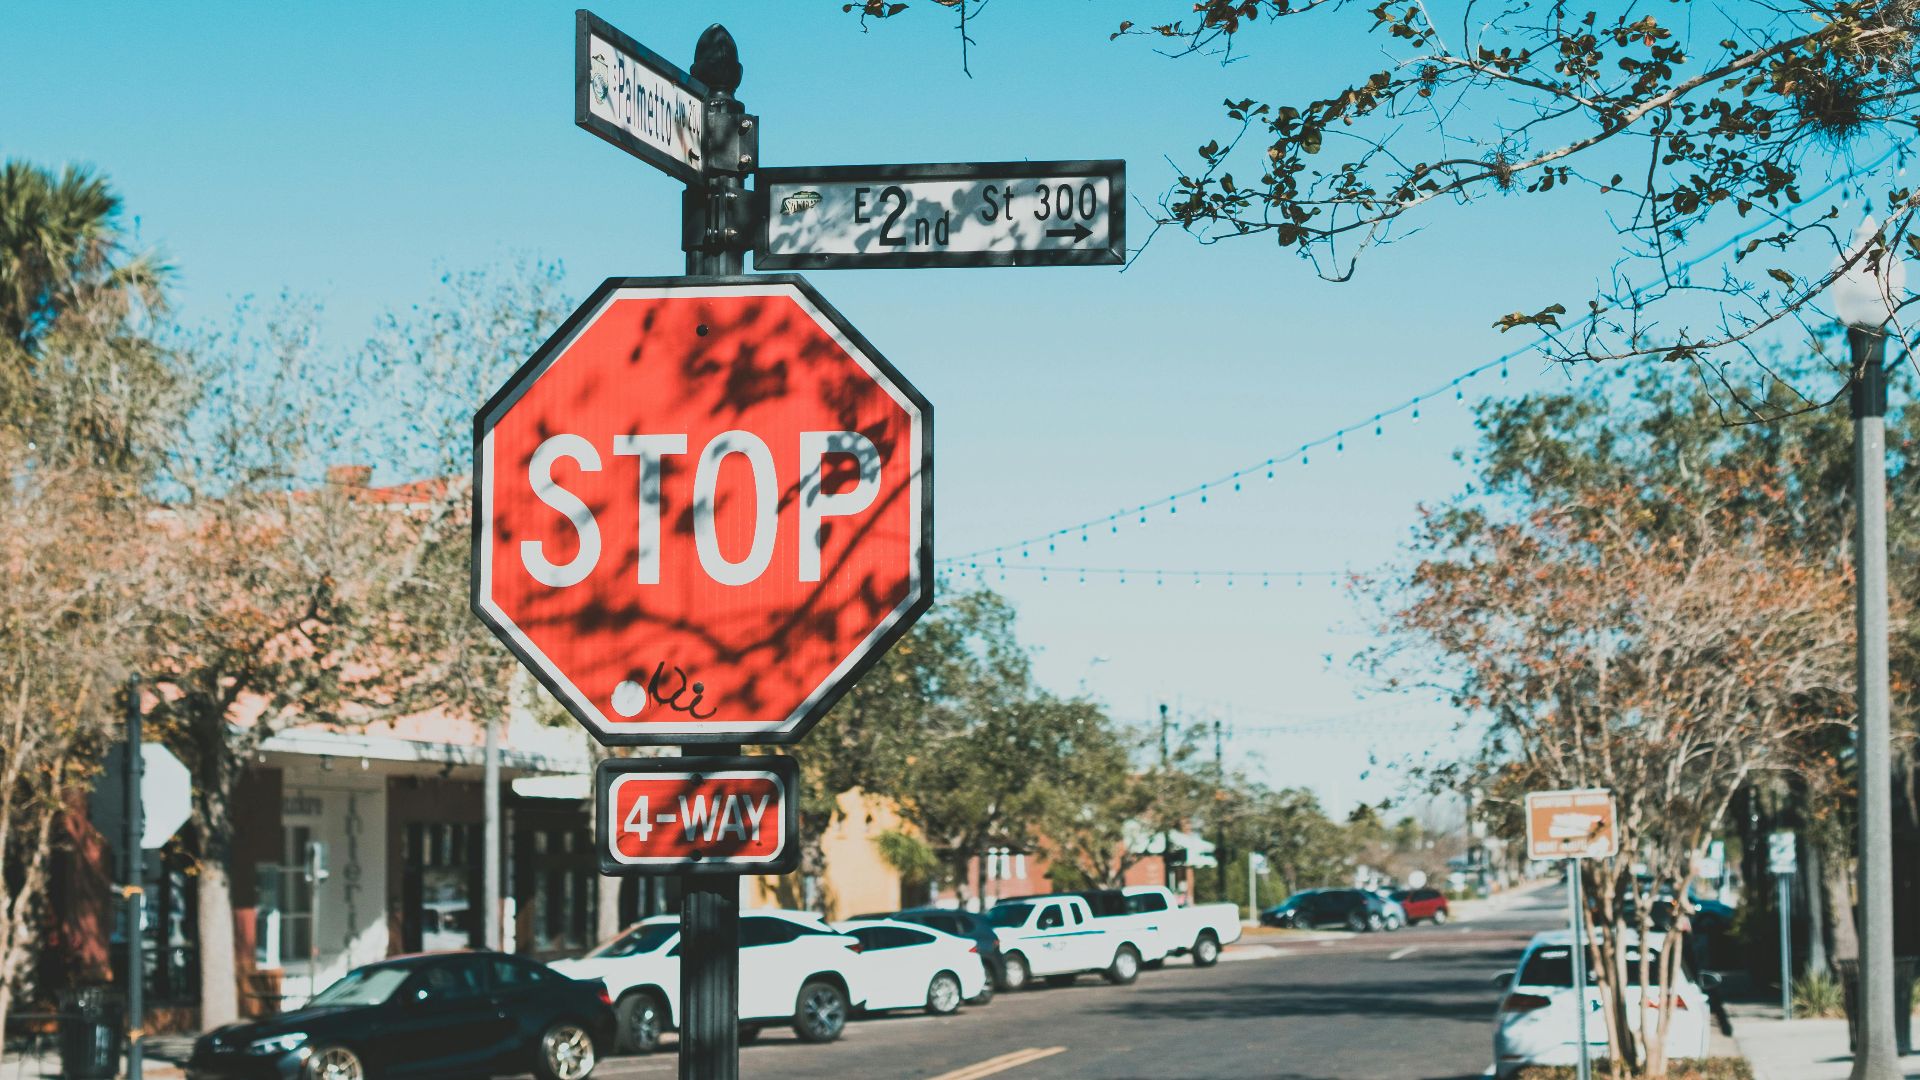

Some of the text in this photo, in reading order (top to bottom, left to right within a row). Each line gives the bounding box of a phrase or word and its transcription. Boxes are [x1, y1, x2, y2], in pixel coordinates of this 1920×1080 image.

[618, 57, 672, 146] Palmetto
[674, 92, 686, 129] Ave
[854, 187, 871, 224] E
[879, 186, 950, 247] 2nd
[981, 184, 1015, 222] St
[1033, 183, 1097, 221] 300
[520, 429, 882, 587] STOP
[623, 795, 771, 842] 4-WAY
